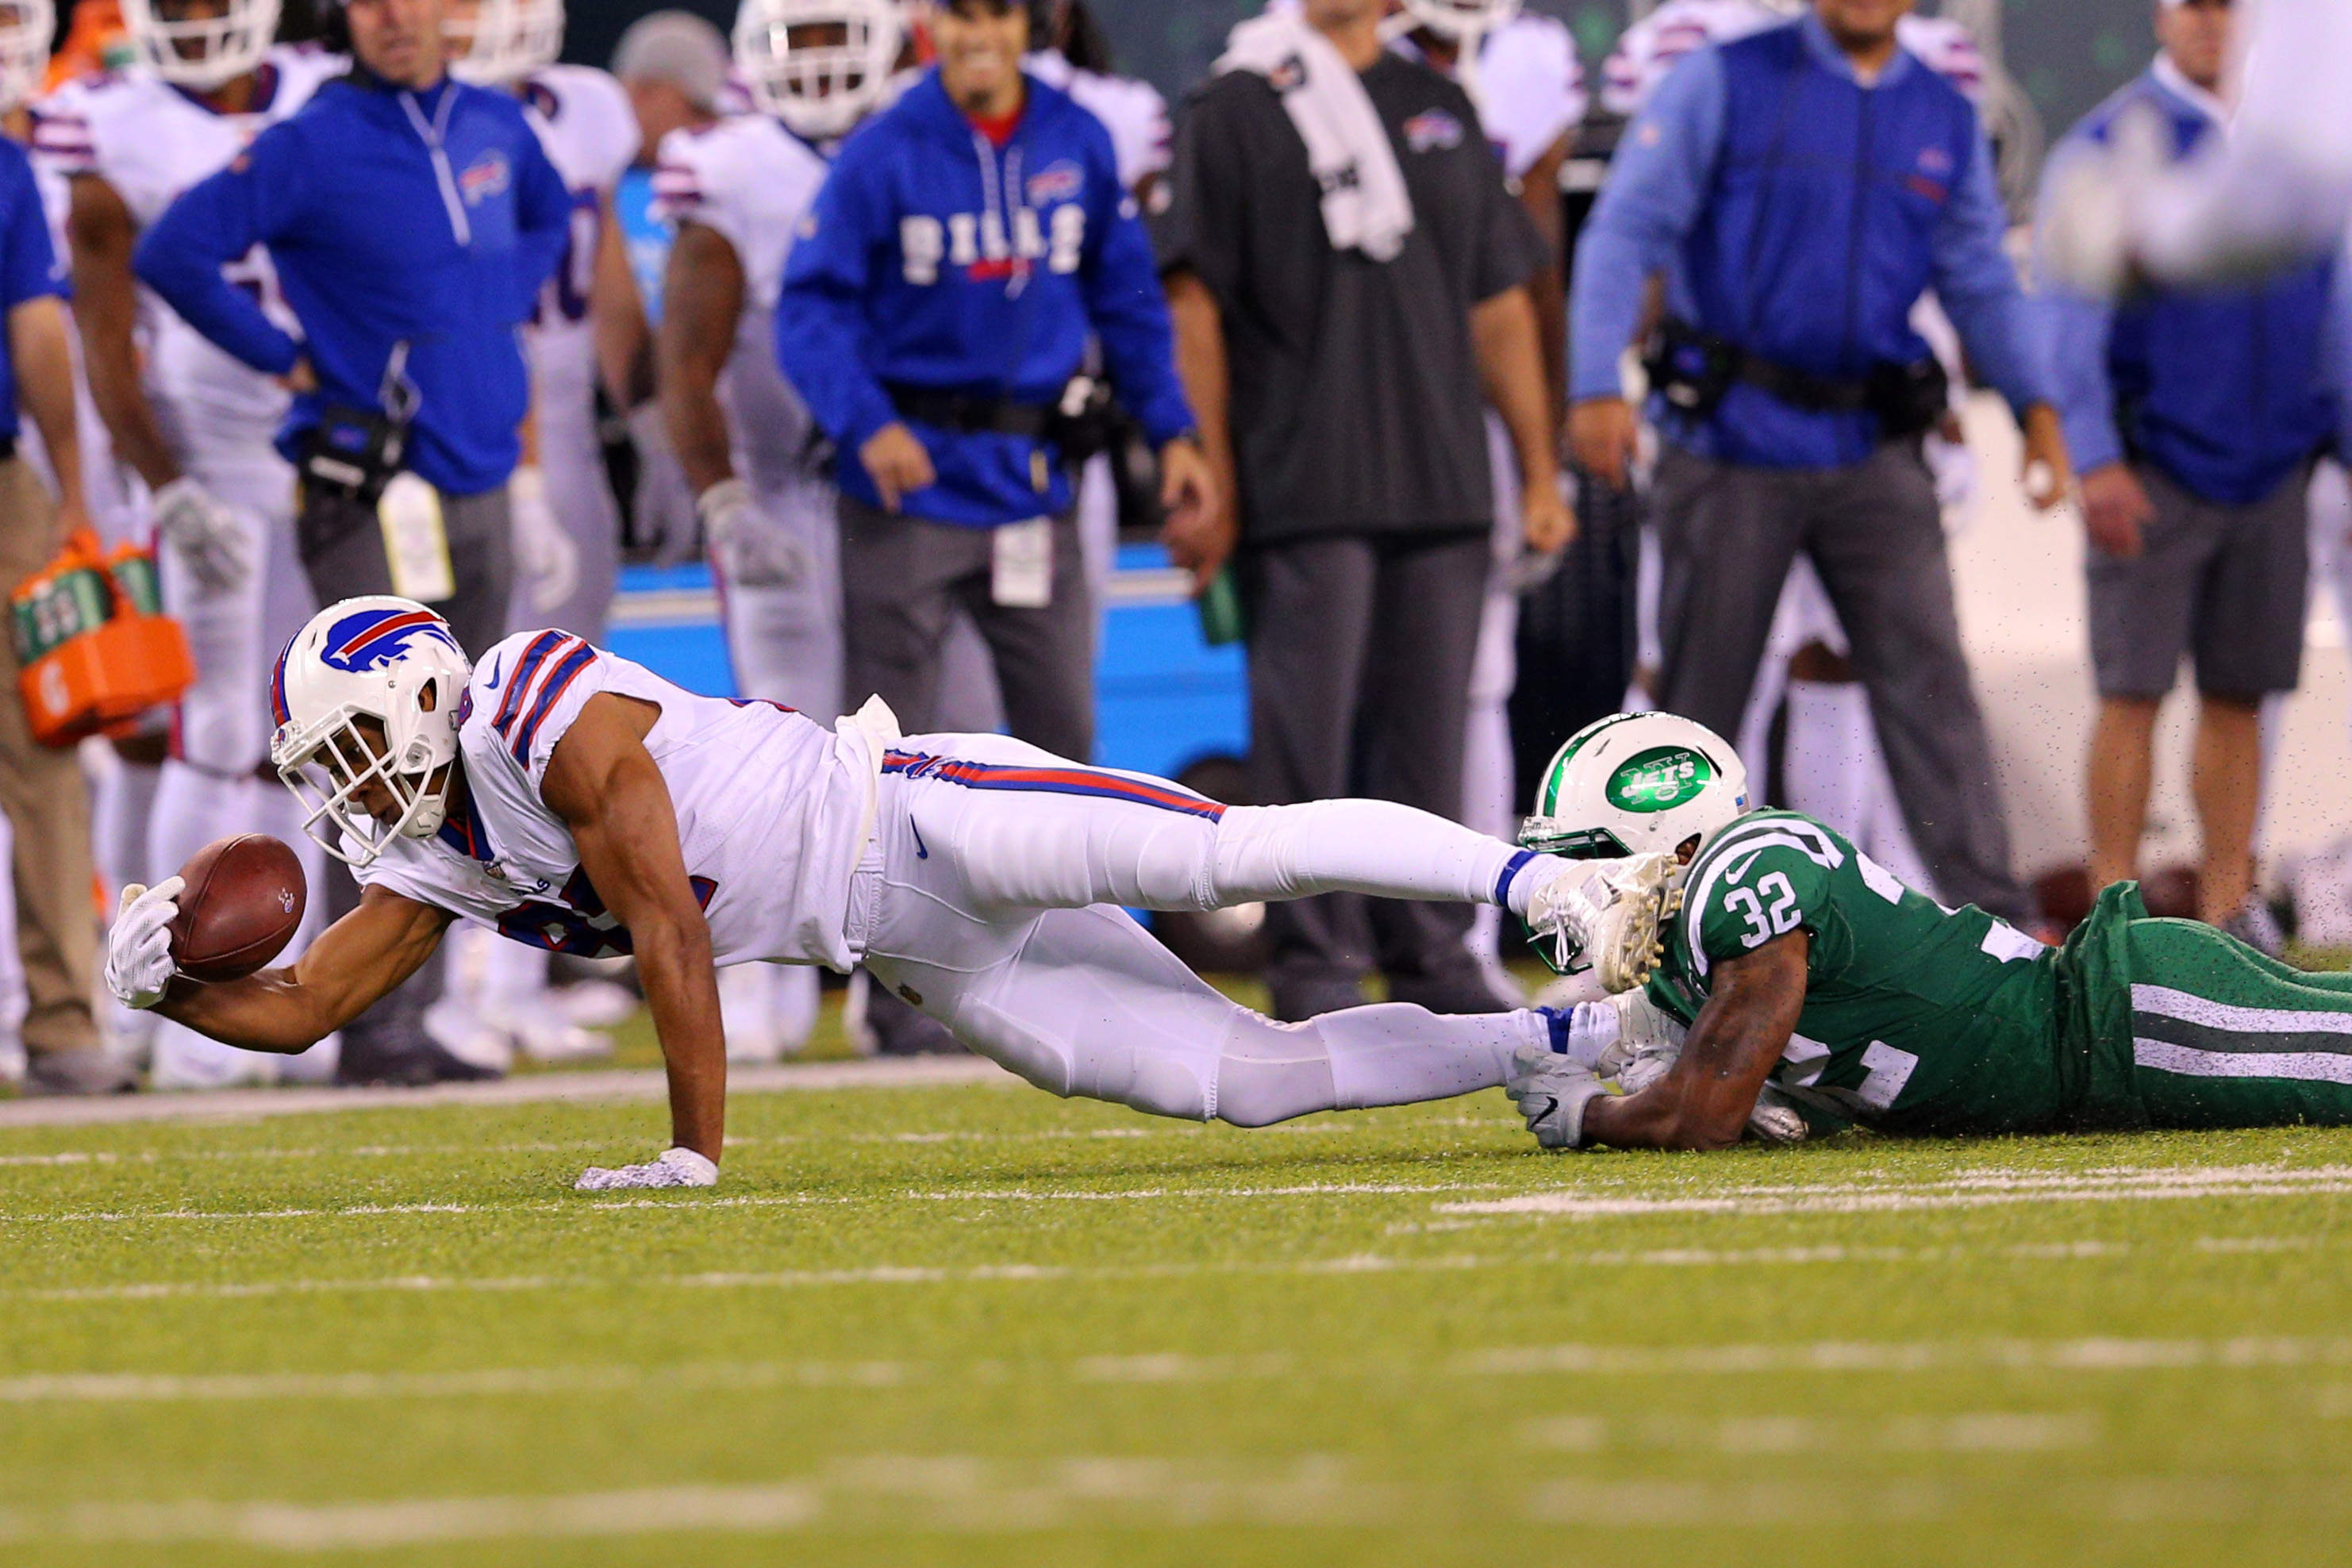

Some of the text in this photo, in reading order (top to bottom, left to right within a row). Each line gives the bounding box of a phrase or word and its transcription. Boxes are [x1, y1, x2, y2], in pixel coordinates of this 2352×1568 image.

[899, 203, 1087, 286] BILLS
[1620, 761, 1695, 799] JETS
[1723, 870, 1802, 949] 32
